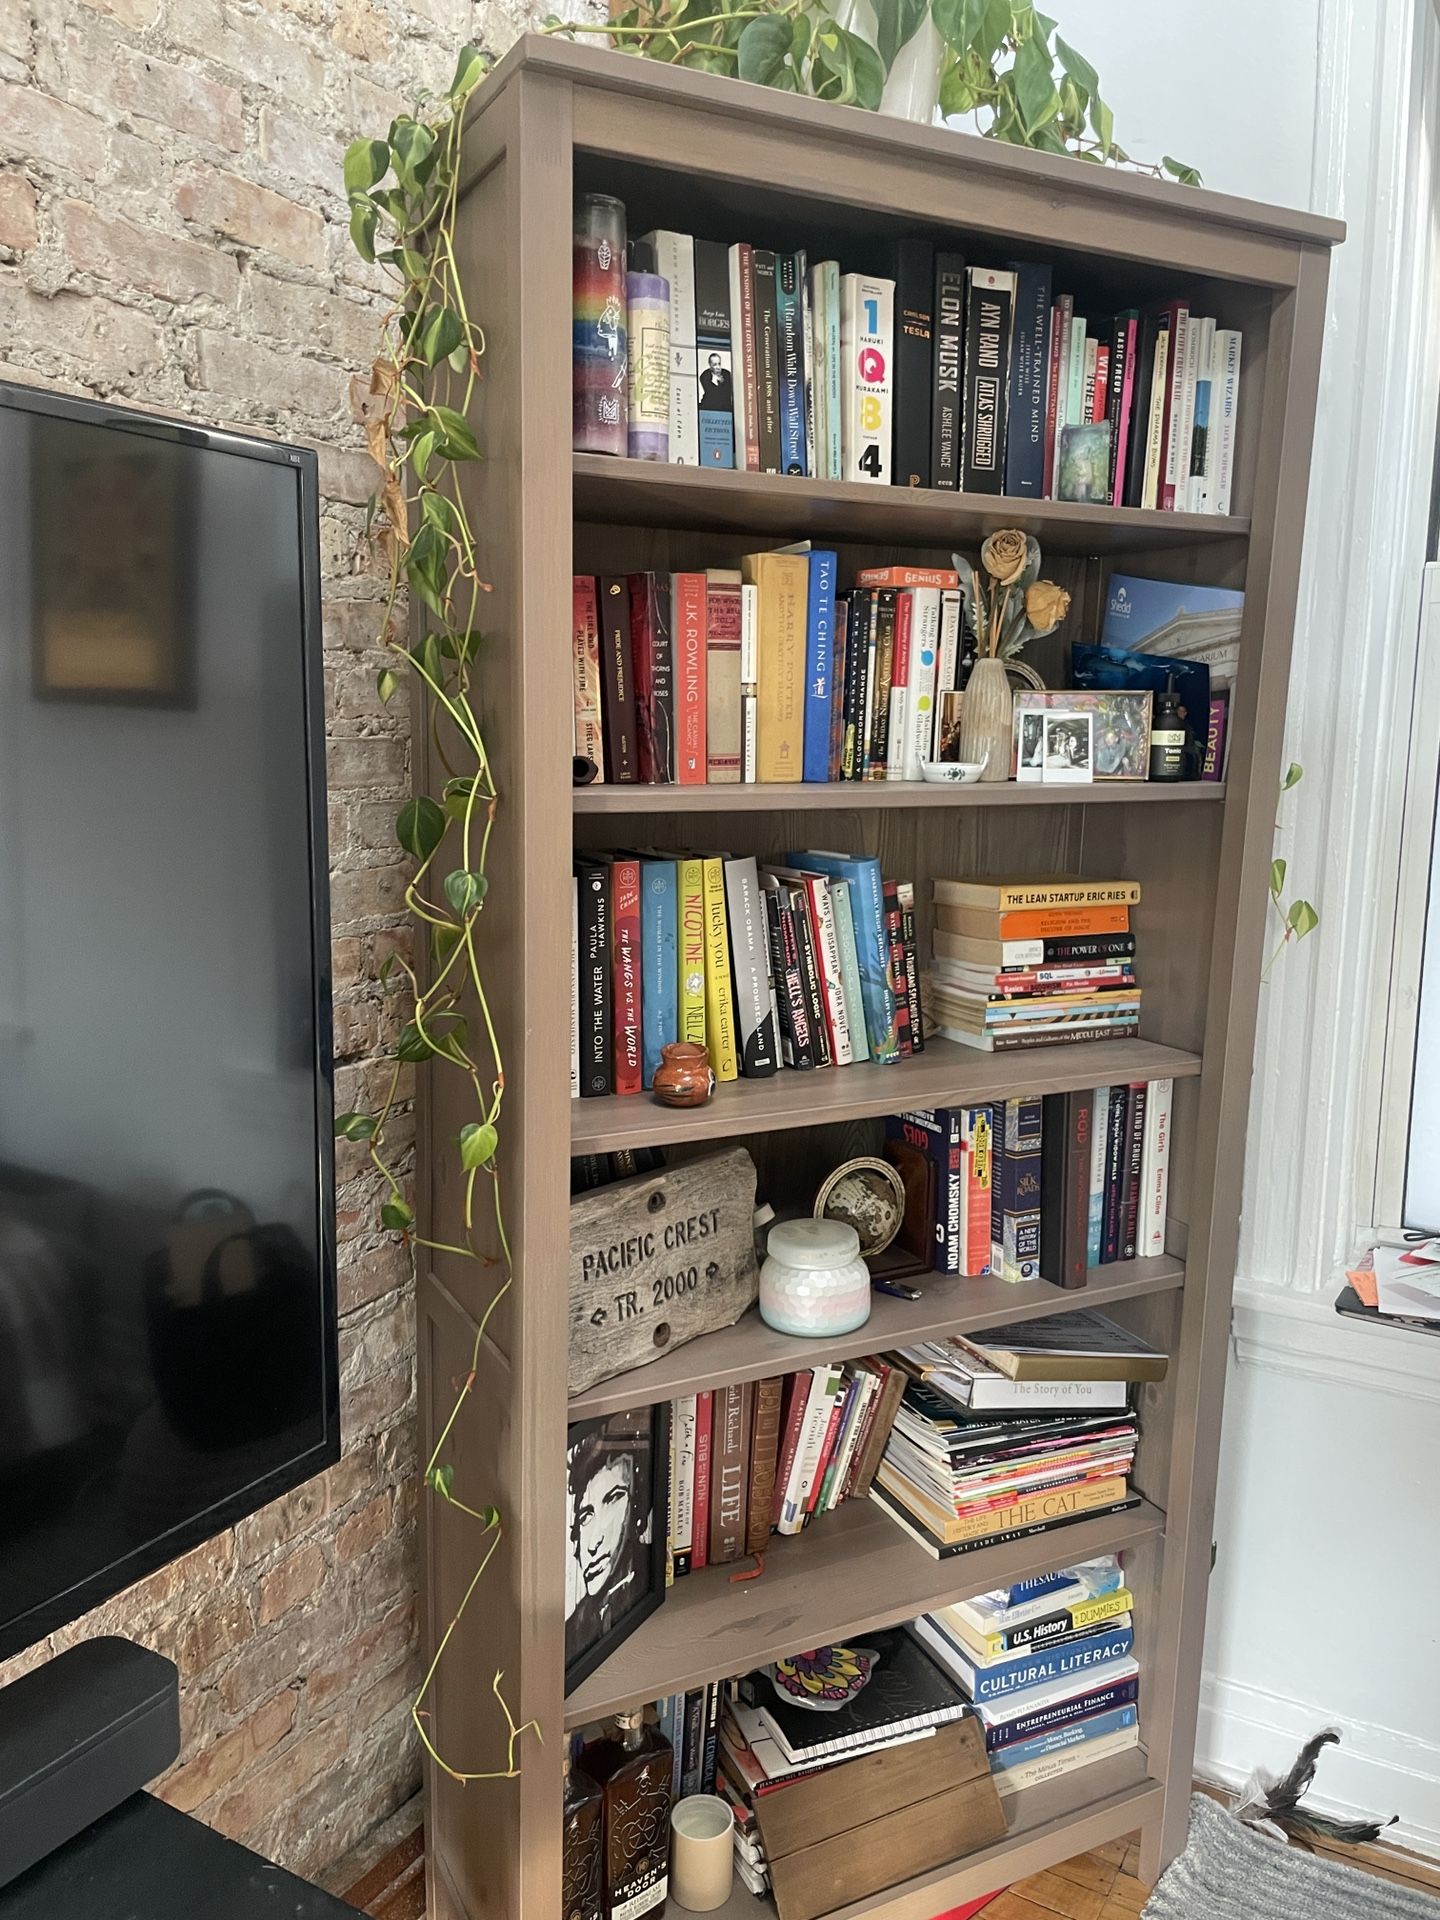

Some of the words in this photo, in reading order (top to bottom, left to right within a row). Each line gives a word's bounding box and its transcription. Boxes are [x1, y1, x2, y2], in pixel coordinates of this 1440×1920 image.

[784, 298, 794, 308] A
[942, 272, 960, 326] ELON
[1036, 286, 1046, 310] THE
[700, 316, 730, 328] BORGES
[785, 308, 796, 352] Random
[903, 310, 930, 322] CARLSON
[980, 302, 1001, 330] AYN
[860, 336, 884, 344] HARUKI
[903, 325, 930, 339] TESLA
[1116, 332, 1125, 360] BASIC
[787, 354, 798, 376] Walk
[858, 347, 886, 384] Q
[938, 334, 959, 392] MUSK
[979, 333, 998, 368] RAND
[1030, 314, 1044, 404] WELL-TRAINED
[1226, 336, 1238, 375] MARKET
[1099, 355, 1108, 384] WTF
[1114, 364, 1124, 394] FREUD
[788, 379, 799, 406] Down
[856, 385, 888, 394] MURAKAMI
[978, 381, 994, 411] ATLAS
[1224, 378, 1235, 418] WIZARDS
[788, 406, 800, 430] Wall
[942, 406, 954, 439] ASHLEE
[1030, 409, 1040, 444] MIND
[790, 430, 800, 460] Street
[940, 440, 952, 468] VANCE
[975, 413, 992, 465] SHRUGGED
[858, 444, 882, 478] 4
[820, 561, 830, 590] TAO
[904, 572, 942, 584] GENIUS
[686, 601, 698, 625] J.K.
[818, 597, 828, 614] TE
[1110, 598, 1132, 614] Shedd
[786, 593, 796, 655] HARRY
[920, 606, 930, 648] Strangers
[928, 606, 938, 636] Talking
[576, 630, 586, 656] PLAYED
[816, 620, 828, 672] CHING
[929, 639, 934, 649] to
[578, 656, 586, 674] WITH
[686, 629, 698, 702] ROWLING
[578, 676, 586, 692] FIRE
[785, 658, 794, 720] POTTER
[856, 710, 864, 762] CLOCKWORK
[914, 714, 922, 752] Gladwell
[1204, 707, 1220, 773] BEAUTY
[742, 878, 751, 915] BARACK
[822, 894, 831, 916] WAYS
[1007, 894, 1024, 904] THE
[1026, 894, 1047, 904] LEAN
[1048, 892, 1084, 902] STARTUP
[1086, 891, 1106, 901] ERIC
[1107, 890, 1126, 900] RIES
[596, 897, 606, 947] HAWKINS
[684, 894, 703, 966] NICOTINE
[710, 902, 723, 938] lucky
[825, 920, 832, 929] TO
[870, 868, 880, 909] REMARKABLY
[877, 934, 885, 968] CREATURES
[590, 925, 598, 958] PAULA
[621, 929, 630, 944] THE
[745, 919, 754, 951] OBAMA
[1057, 946, 1072, 956] THE
[1072, 945, 1097, 954] POWER
[1108, 943, 1124, 952] ONE
[622, 946, 634, 988] WANGS
[710, 944, 724, 968] you
[826, 932, 838, 975] DISAPPEAR
[593, 966, 603, 1005] WATER
[804, 944, 816, 990] SYMBOLIC
[812, 992, 821, 1019] LOGIC
[905, 956, 916, 988] THOUSAND
[1039, 972, 1054, 980] SQL
[626, 992, 634, 1004] VS.
[718, 988, 729, 1015] erika
[786, 972, 804, 1007] HELL'S
[834, 988, 844, 1007] IDRA
[908, 988, 919, 1018] SPLENDID
[594, 1010, 603, 1032] THE
[626, 1008, 635, 1022] THE
[752, 976, 761, 1023] PROMISED
[757, 1028, 765, 1051] LAND
[792, 1009, 810, 1047] ANGELS
[836, 1010, 846, 1034] NOVEY
[911, 1018, 920, 1034] SUNS
[624, 1025, 638, 1067] WORLD
[720, 1018, 730, 1050] carter
[594, 1036, 604, 1063] INTO
[1076, 1108, 1088, 1144] ROD
[1159, 1112, 1167, 1129] The
[1158, 1132, 1166, 1152] Girls
[1156, 1168, 1164, 1192] Emma
[948, 1174, 960, 1232] CHOMSKY
[1154, 1195, 1162, 1215] Cline
[582, 1234, 656, 1282] PACIFIC
[664, 1208, 720, 1250] CREST
[947, 1234, 959, 1270] NOAM
[1018, 1233, 1038, 1241] HISTORY
[614, 1290, 644, 1322] TR.
[652, 1266, 698, 1306] 2000
[728, 1385, 738, 1404] eith
[1013, 1384, 1030, 1394] The
[1034, 1384, 1059, 1396] Story
[1062, 1383, 1072, 1394] of
[1074, 1384, 1092, 1394] You
[727, 1406, 739, 1454] Richards
[794, 1400, 806, 1432] MASTER
[806, 1407, 824, 1450] Picoult
[817, 1420, 828, 1438] Jodi
[780, 1448, 795, 1496] MARGARITA
[720, 1464, 742, 1527] LIFE
[993, 1506, 1036, 1528] THE
[1042, 1490, 1082, 1515] CAT
[1080, 1600, 1120, 1624] DUMMIES
[1013, 1630, 1032, 1644] U.S.
[1034, 1618, 1068, 1640] History
[980, 1666, 1056, 1694] CULTURAL
[1060, 1640, 1129, 1672] LITERACY
[1016, 1703, 1082, 1730] ENTREPRENEURIAL
[1084, 1692, 1114, 1708] FINANCE
[704, 1735, 716, 1782] TECHNICAL
[1025, 1770, 1037, 1778] The
[1038, 1763, 1057, 1774] Minus
[1058, 1756, 1076, 1767] Times
[1034, 1768, 1064, 1782] COLLECTED
[614, 1860, 666, 1897] HEAVEN'S
[627, 1876, 656, 1898] DOOR
